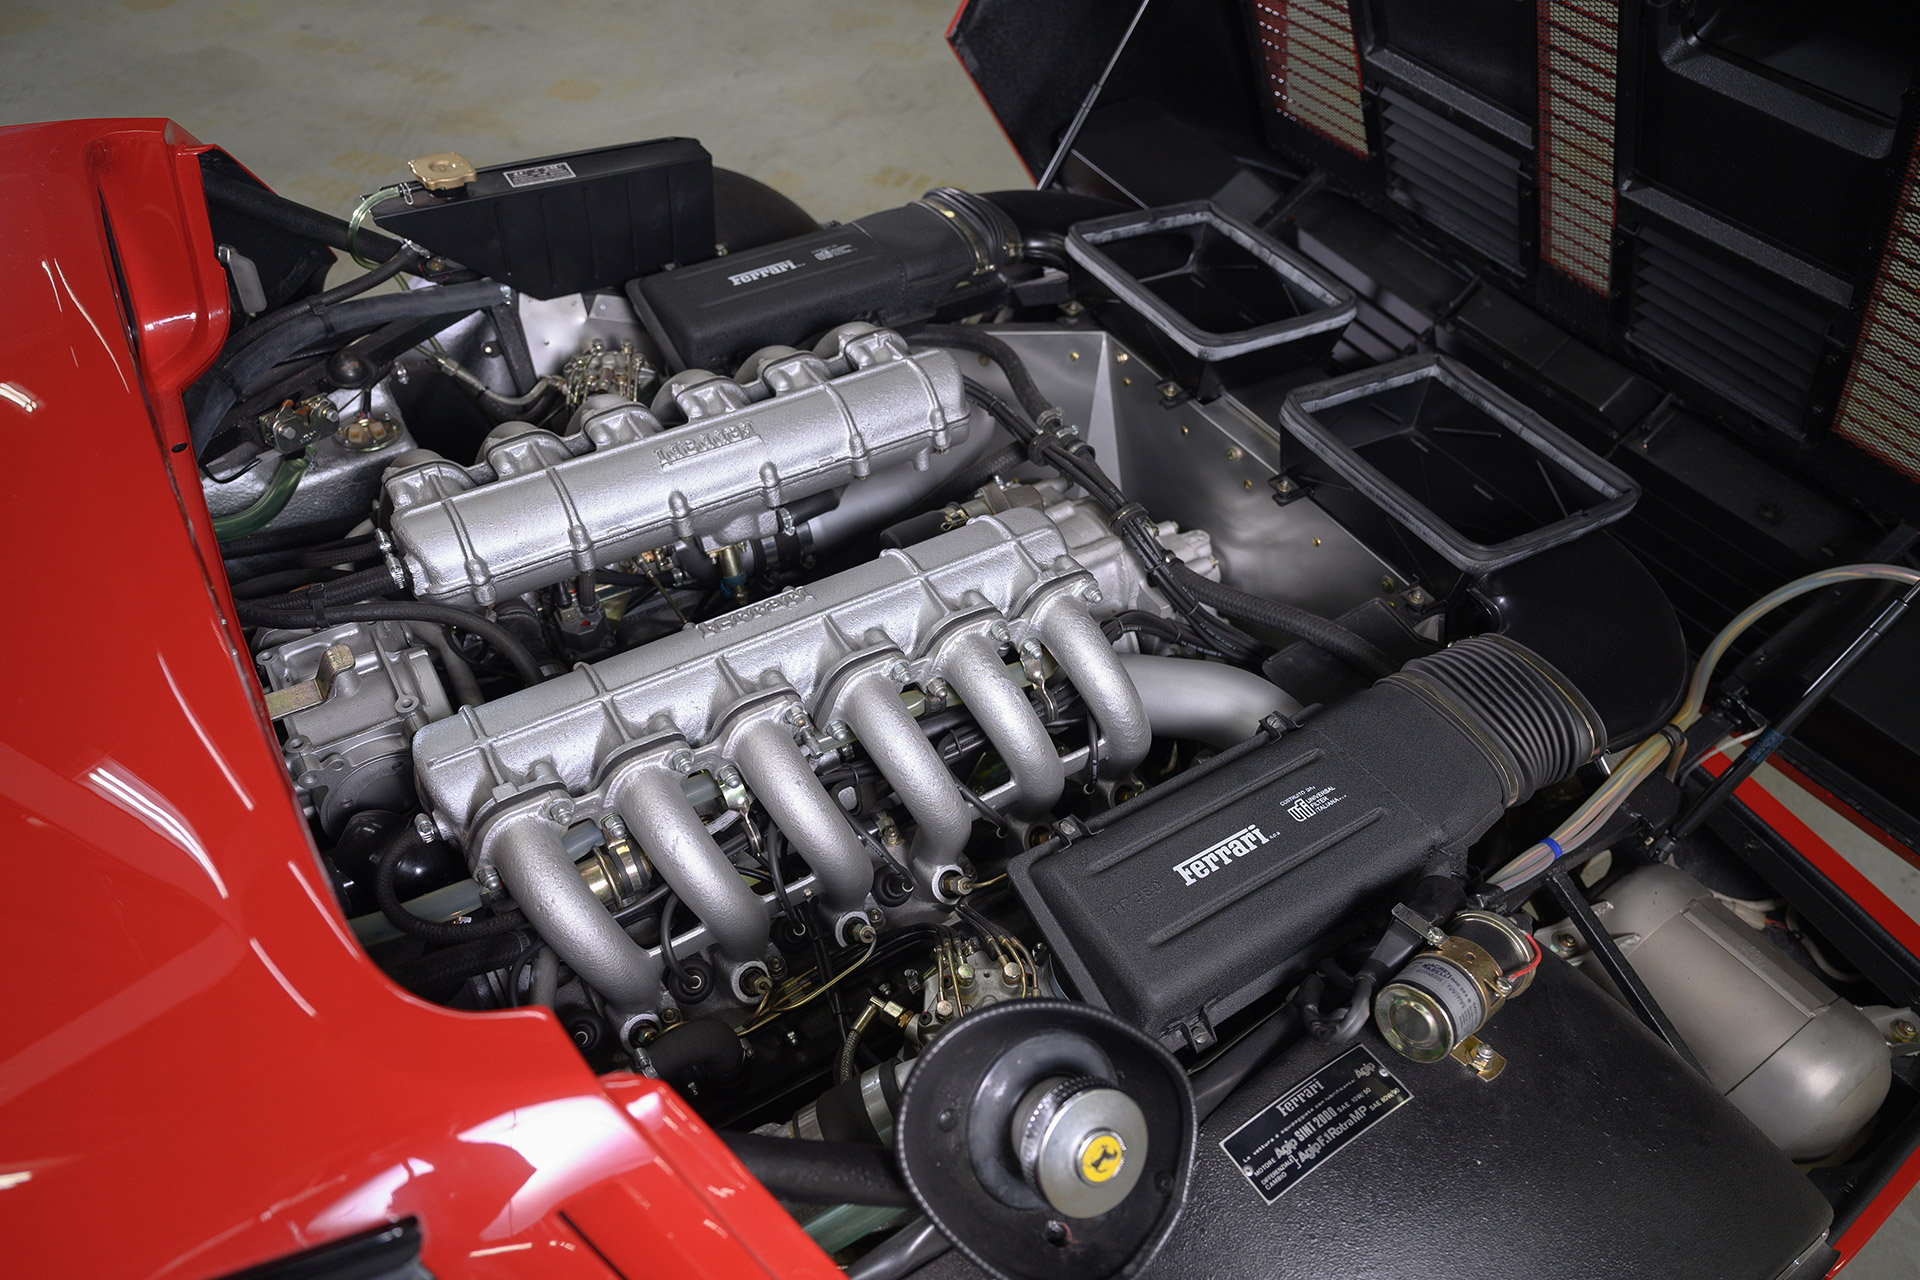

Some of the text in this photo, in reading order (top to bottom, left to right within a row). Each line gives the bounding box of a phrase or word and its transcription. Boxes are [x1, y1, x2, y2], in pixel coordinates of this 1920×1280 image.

[728, 259, 797, 286] Ferrari
[1173, 824, 1270, 887] Ferrari
[1353, 1062, 1376, 1079] Agip
[1275, 1078, 1325, 1118] Ferrari
[1368, 1099, 1382, 1111] SAE
[1253, 1156, 1277, 1177] MOTORE
[1274, 1139, 1299, 1160] Agip
[1294, 1120, 1317, 1142] SINT
[1312, 1106, 1338, 1130] 2000
[1336, 1101, 1351, 1113] SAE
[1264, 1171, 1288, 1190] CAMBIO
